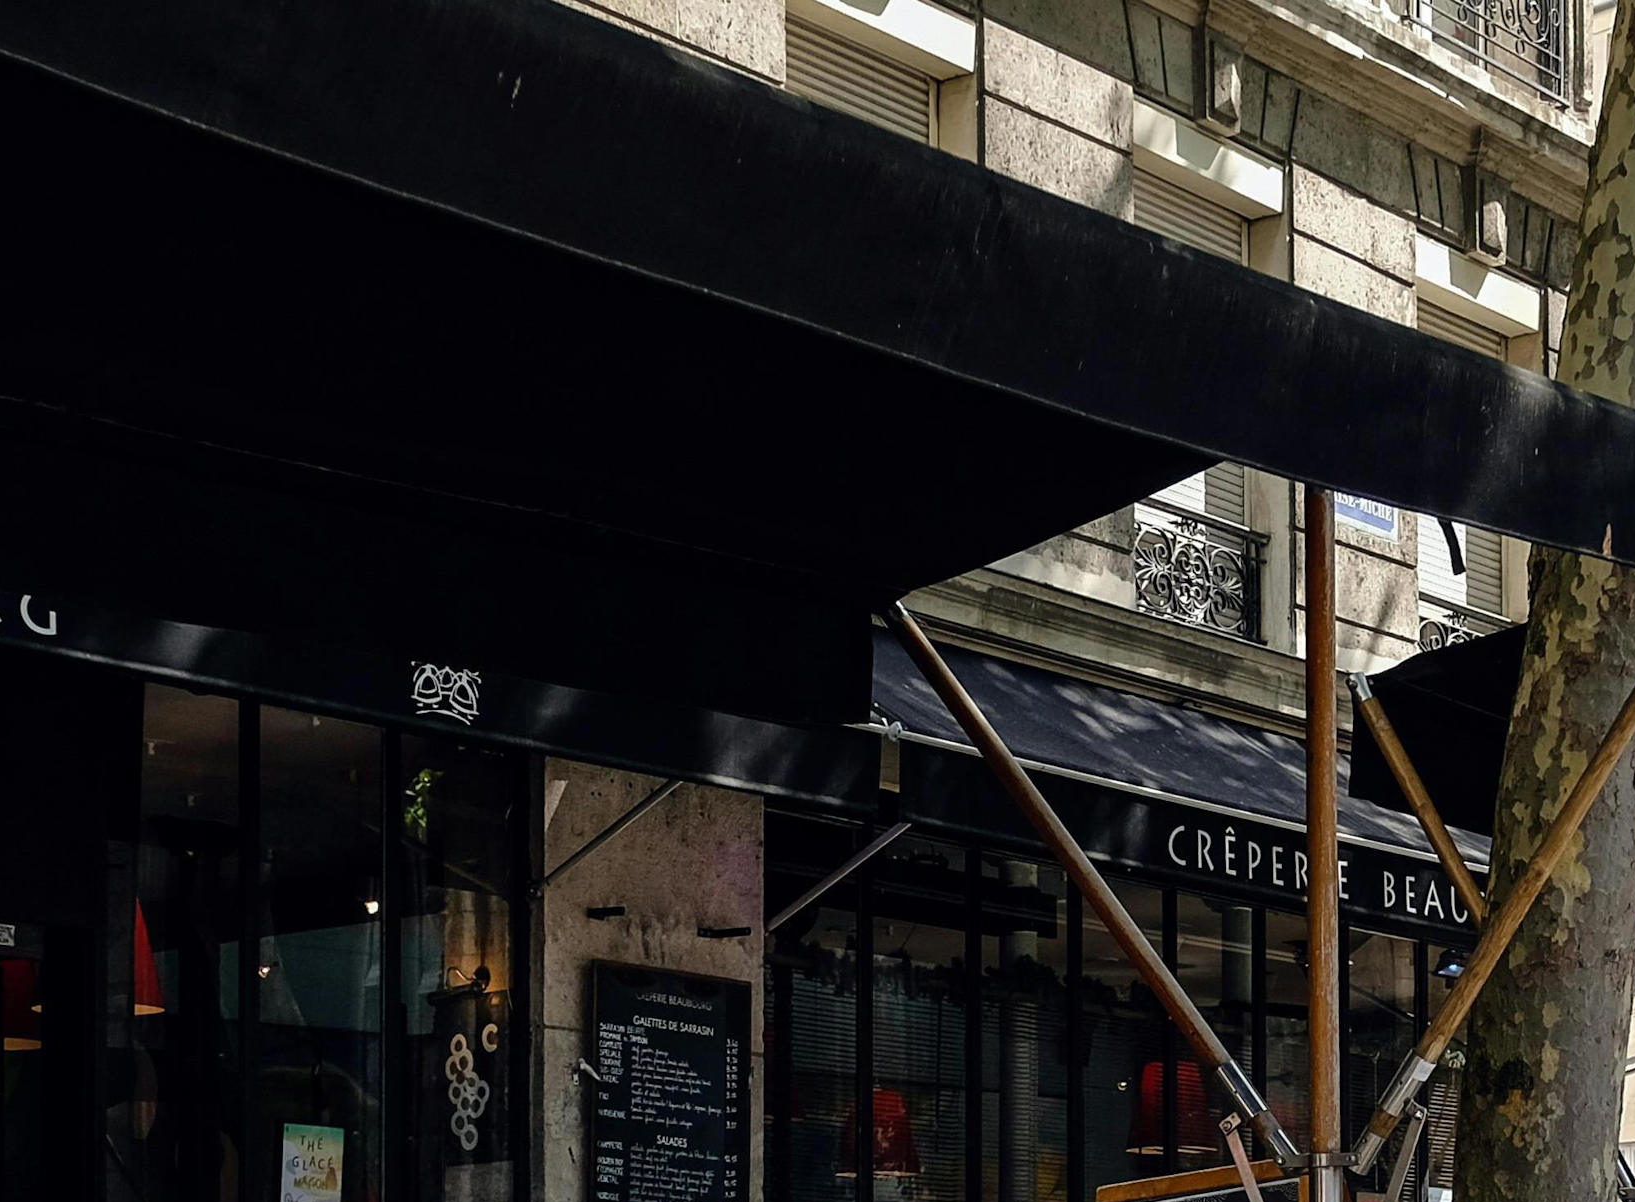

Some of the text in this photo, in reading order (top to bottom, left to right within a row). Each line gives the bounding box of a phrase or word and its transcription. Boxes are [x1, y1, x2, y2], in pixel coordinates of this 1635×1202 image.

[1168, 824, 1350, 900] CRÊPERE
[632, 1014, 715, 1038] GALETTES DE SARRASIN
[299, 1134, 324, 1152] THÉ
[656, 1134, 689, 1150] SALADES
[292, 1155, 334, 1172] GLACÉ
